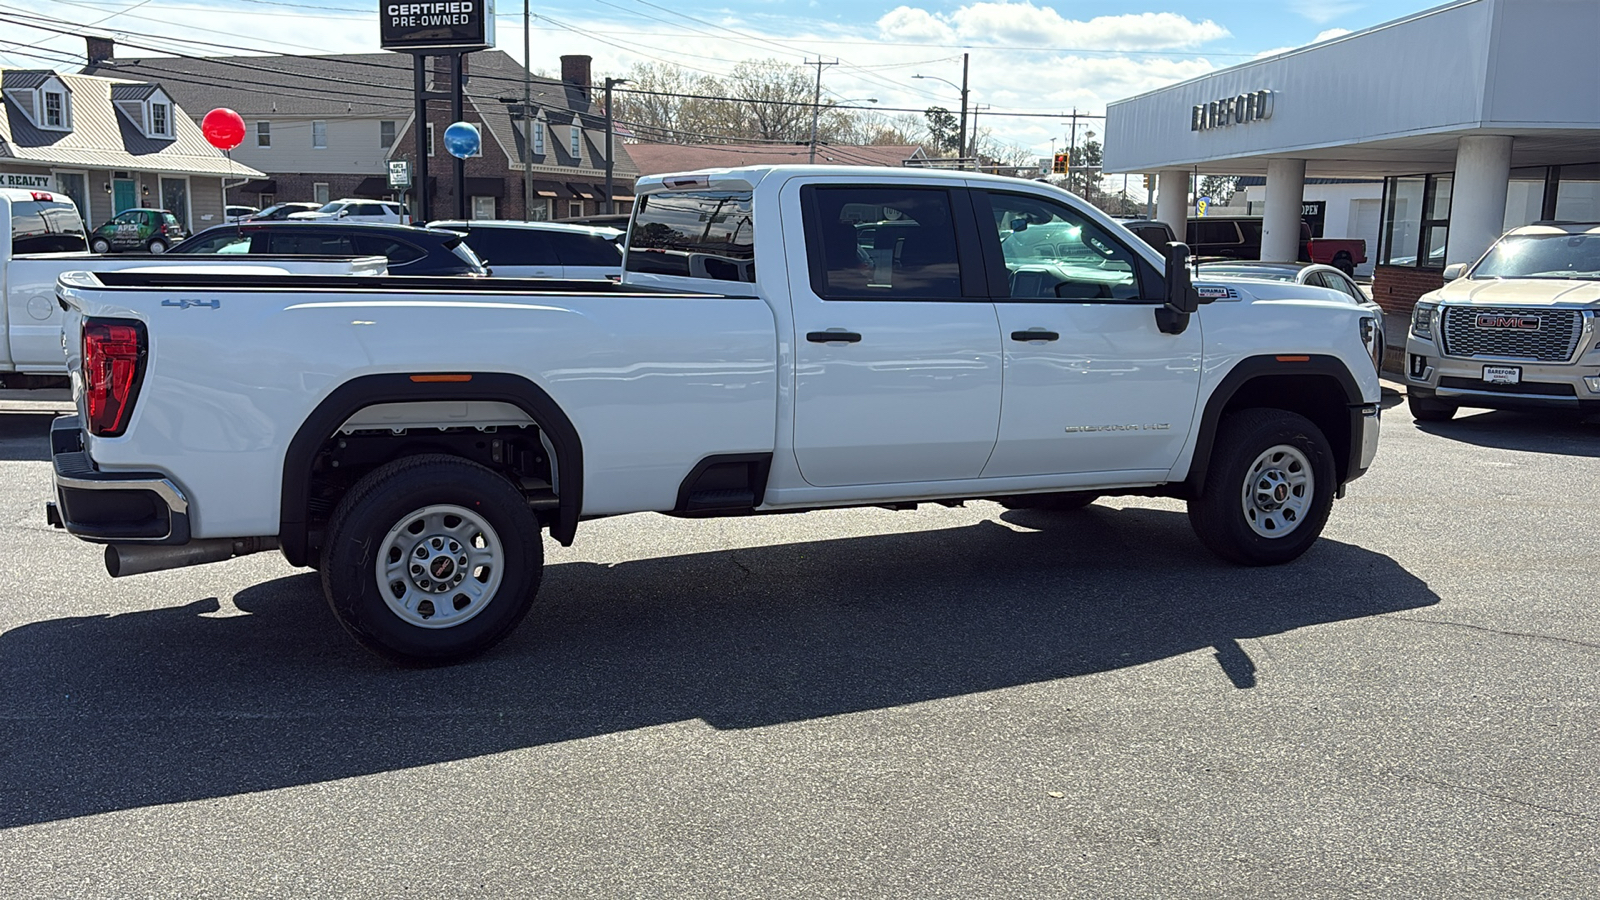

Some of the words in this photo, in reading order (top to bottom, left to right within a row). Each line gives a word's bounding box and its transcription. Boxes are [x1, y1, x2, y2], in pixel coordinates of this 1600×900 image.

[388, 2, 473, 16] CERTIFIED
[392, 14, 469, 27] PRE-OWNED
[1191, 88, 1274, 131] BAREFORD
[8, 175, 49, 187] REALTY
[117, 224, 138, 232] APEX
[1478, 316, 1538, 329] GMC
[1487, 368, 1517, 376] BAREFORD
[1065, 424, 1139, 433] SIERRA
